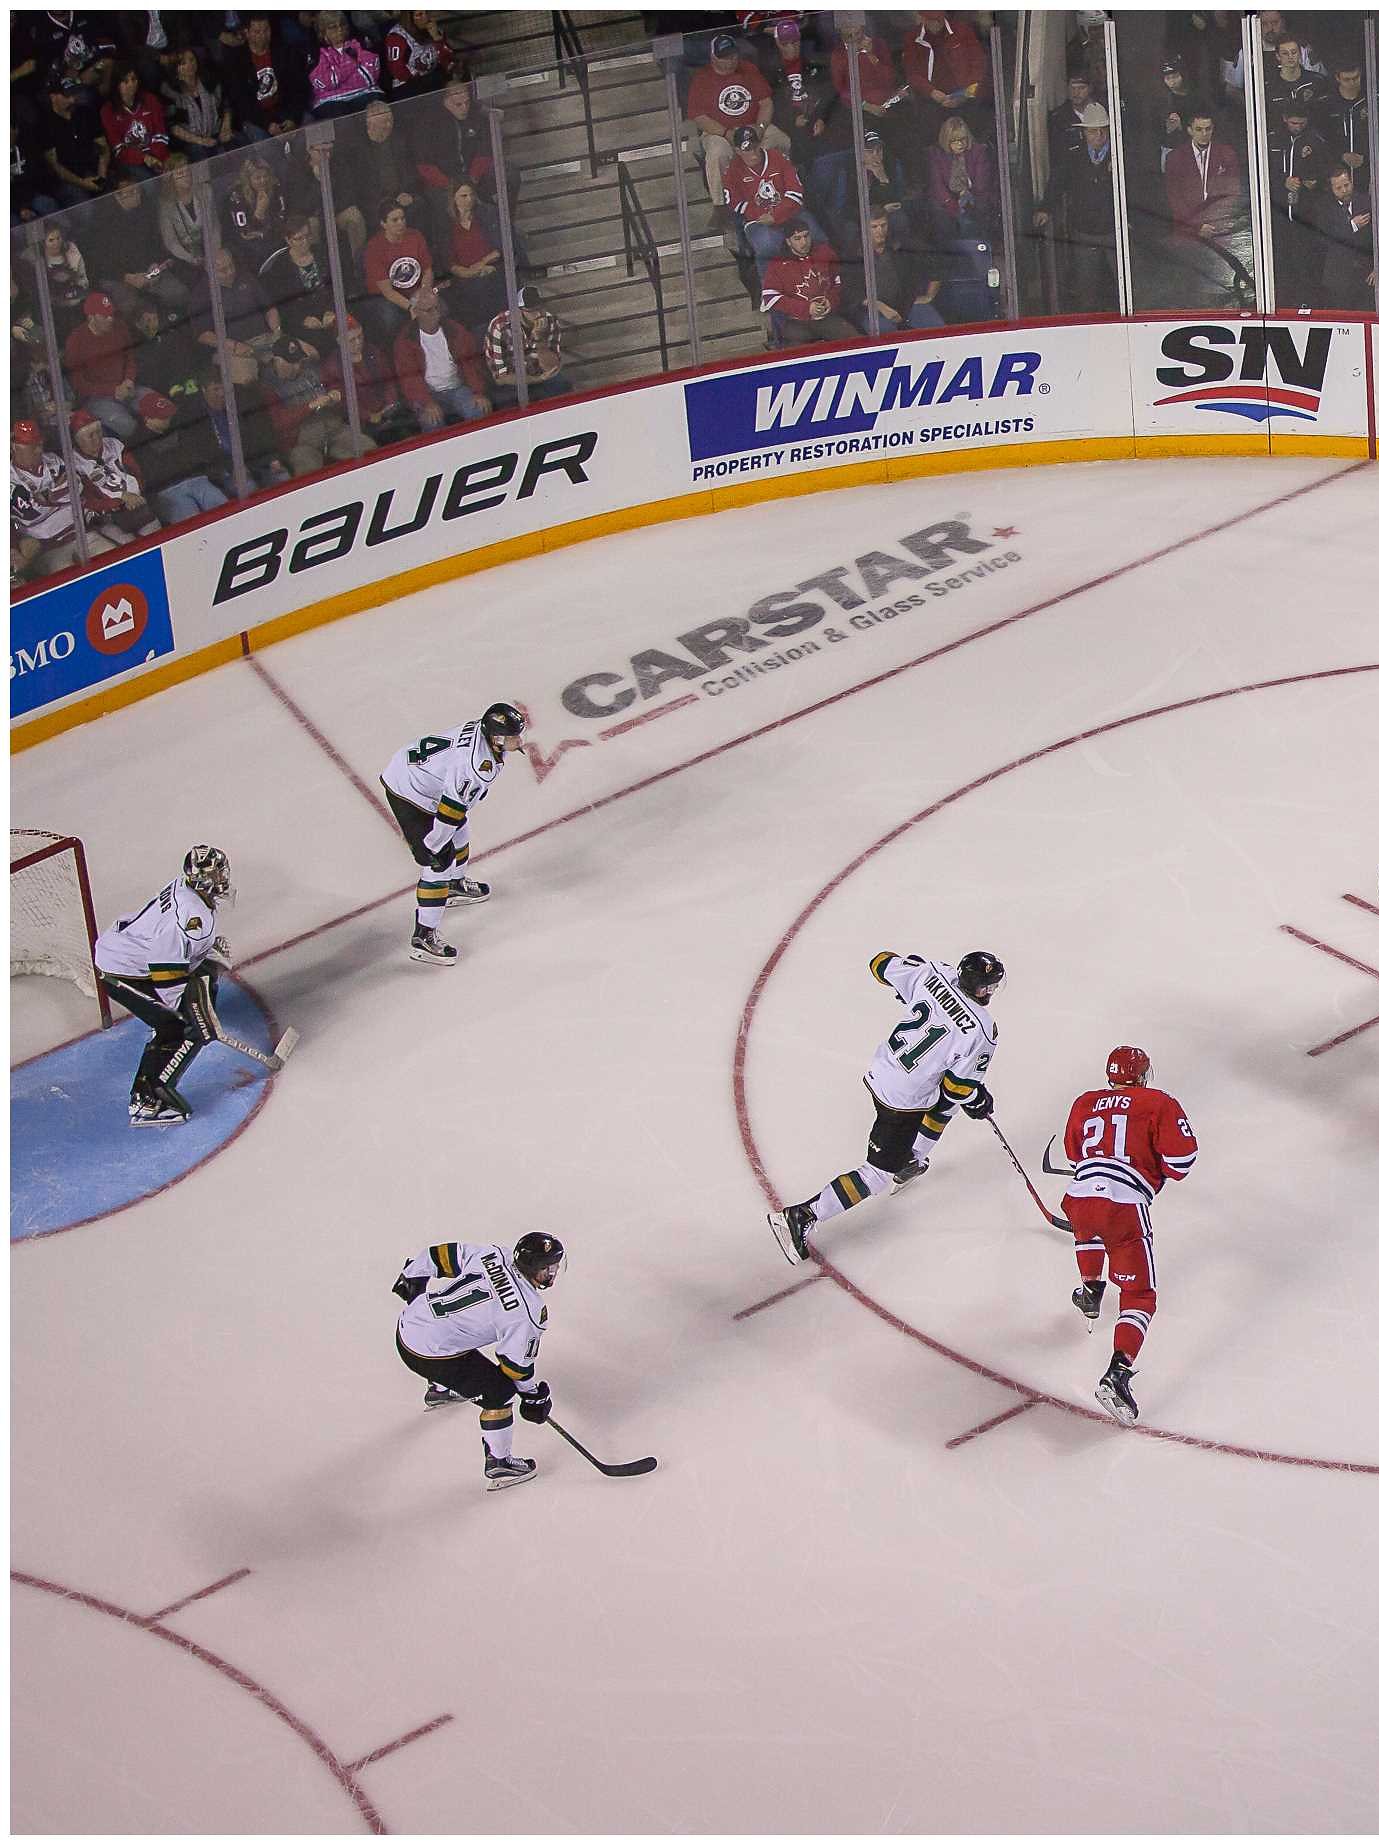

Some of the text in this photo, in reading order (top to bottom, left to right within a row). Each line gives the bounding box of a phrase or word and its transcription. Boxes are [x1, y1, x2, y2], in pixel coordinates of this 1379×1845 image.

[1156, 324, 1334, 392] SN
[755, 351, 1043, 433] WINMAR
[692, 416, 1035, 482] PROPERTY RESTORATION SPECIALISTS
[560, 518, 995, 719] CARSTAR
[700, 550, 1023, 697] Collision & Glass Service
[159, 1038, 195, 1083] VAUGHN
[887, 998, 952, 1074] 21
[1092, 1096, 1131, 1113] JENYS
[1081, 1114, 1131, 1165] 21
[425, 1271, 494, 1320] 11
[480, 1251, 520, 1312] McDONALD
